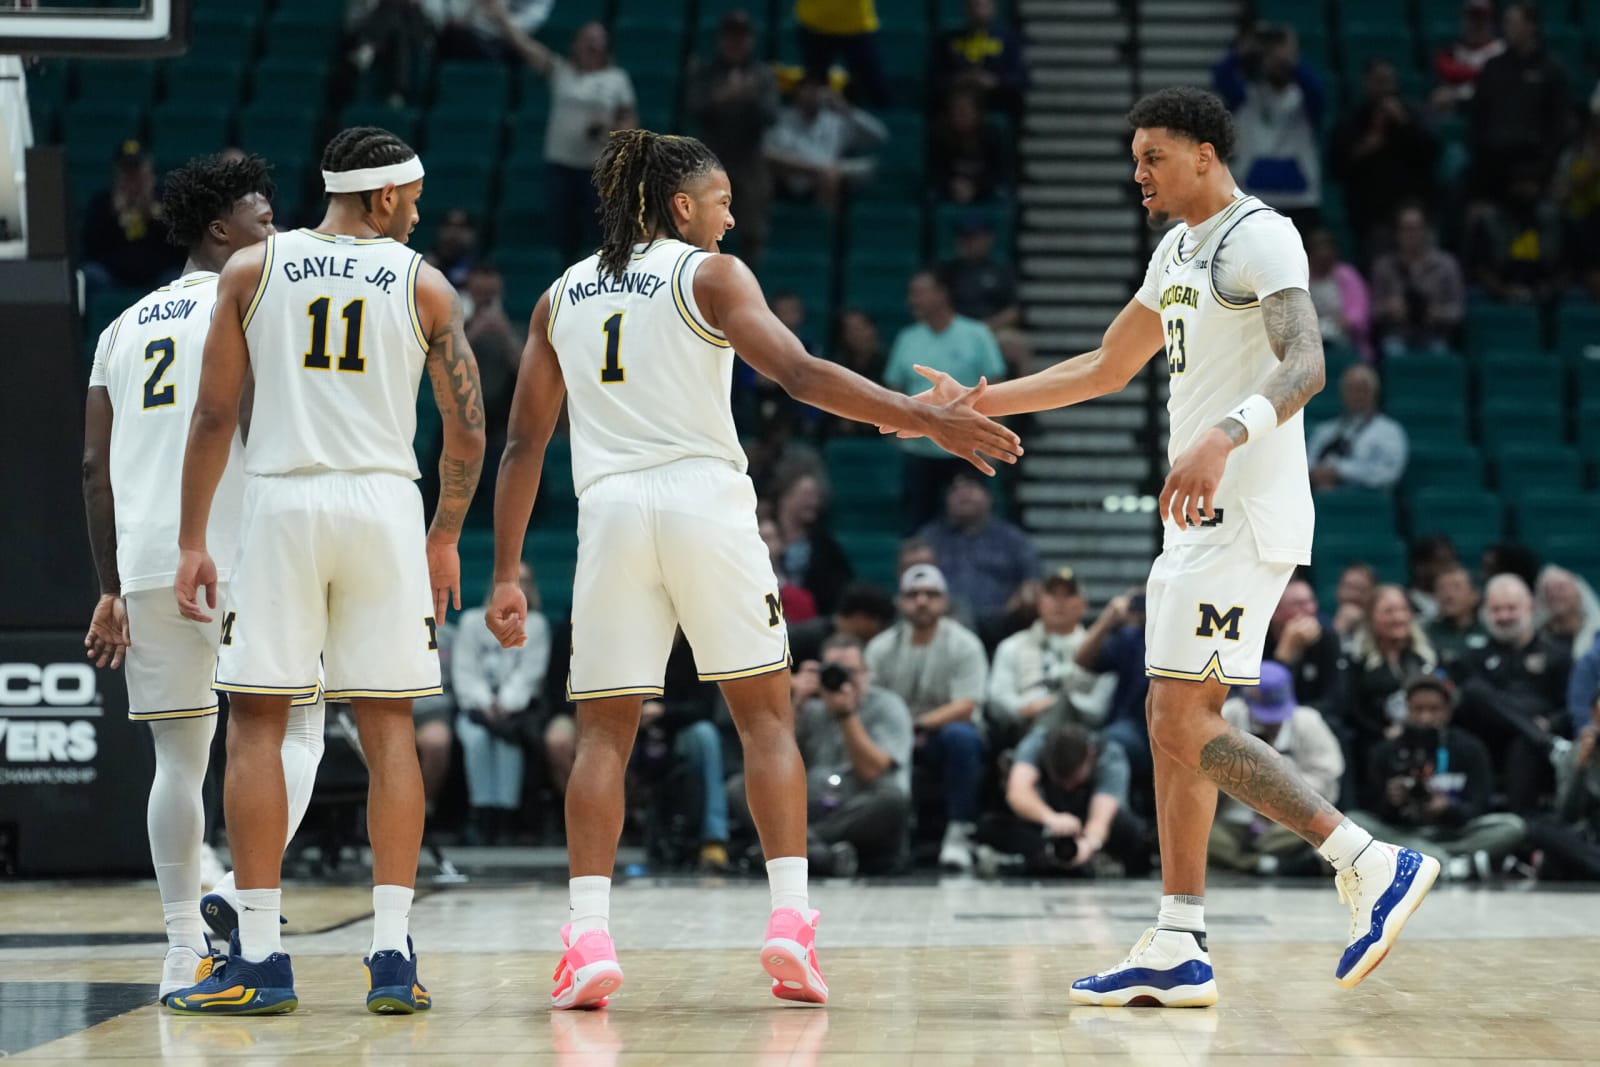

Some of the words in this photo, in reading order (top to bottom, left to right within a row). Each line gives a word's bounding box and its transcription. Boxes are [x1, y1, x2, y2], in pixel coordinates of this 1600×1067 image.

[283, 256, 358, 283] GAYLE
[365, 266, 397, 295] JR.
[138, 299, 197, 325] CASON
[303, 295, 367, 375] 11
[143, 335, 176, 411] 2
[600, 311, 626, 384] 1
[1167, 318, 1187, 375] 23
[1195, 602, 1245, 641] M
